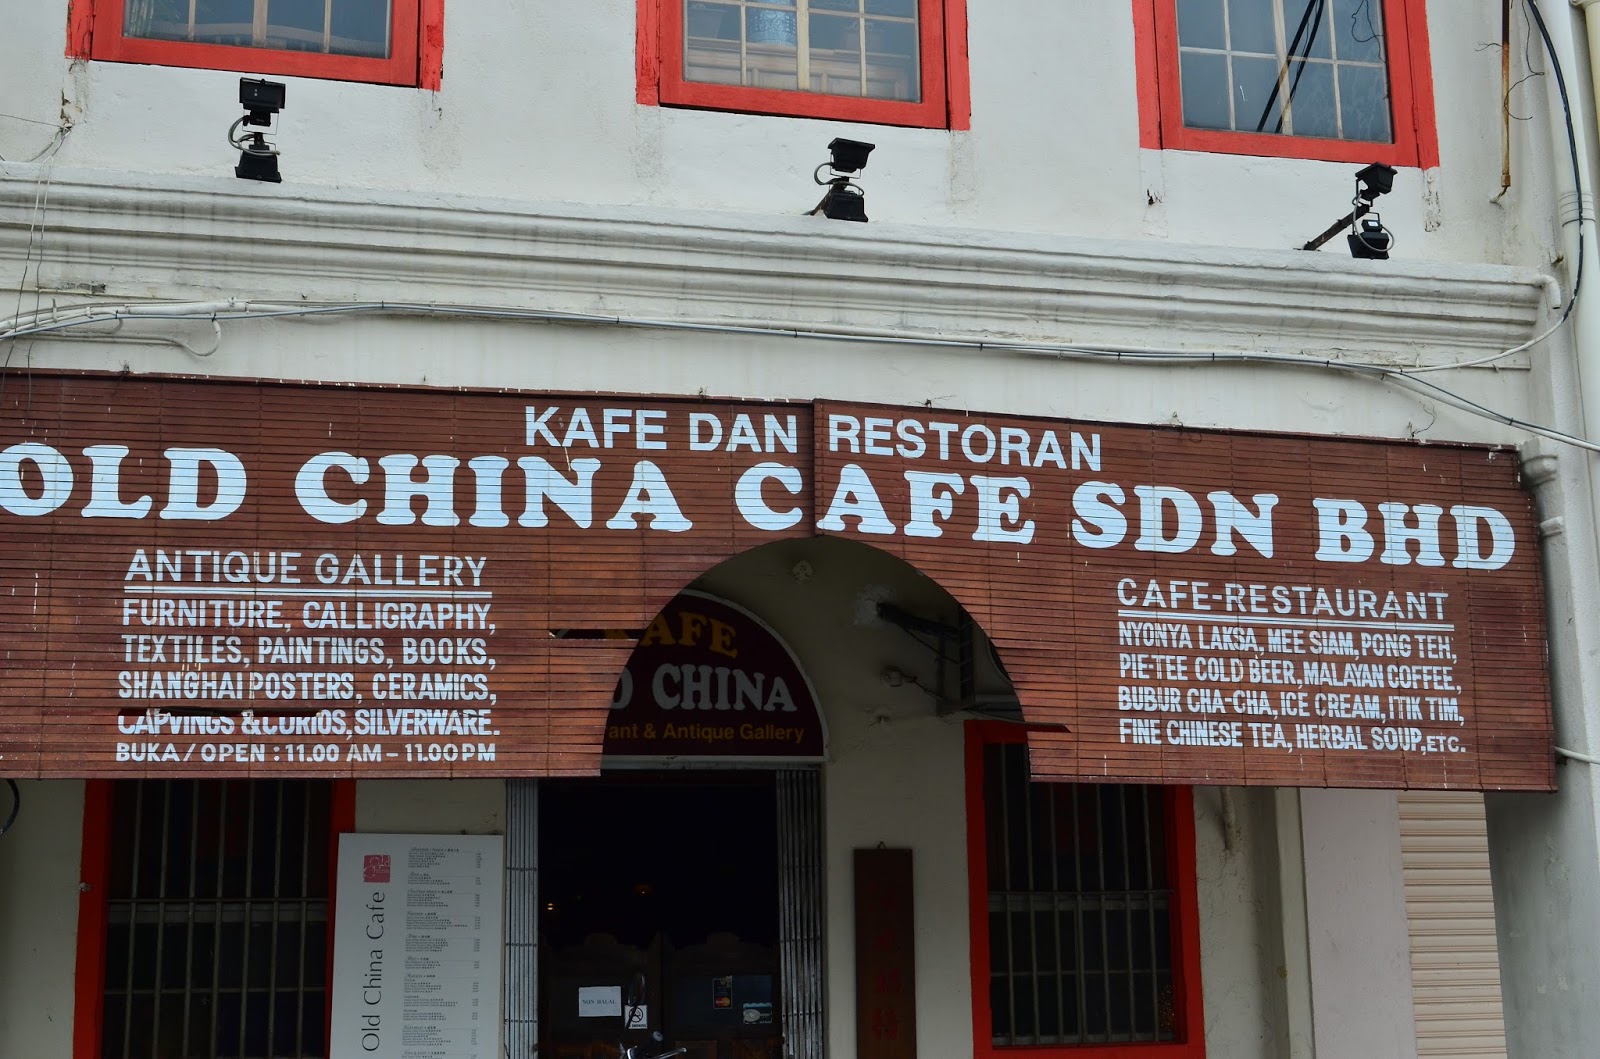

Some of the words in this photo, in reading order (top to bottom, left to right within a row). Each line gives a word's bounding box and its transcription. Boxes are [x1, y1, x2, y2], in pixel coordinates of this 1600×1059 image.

[526, 406, 667, 449] KAFE
[690, 413, 797, 453] DAN
[829, 414, 1102, 472] RESTORAN
[0, 443, 246, 520] OLD
[295, 451, 692, 532] CHINA
[735, 462, 1035, 544] CAFE
[1071, 481, 1279, 559] SDN
[1313, 498, 1515, 569] BHD
[125, 549, 301, 583] ANTIQUE
[315, 554, 486, 586] GALLERY
[123, 599, 291, 632] FURNITURE,
[303, 602, 495, 634] CALLIGRAPHY,
[1118, 578, 1448, 621] CAFE-RESTAURANT
[122, 635, 249, 668] TEXTILES,
[259, 637, 393, 668] PAINTINGS,
[403, 638, 495, 669] BOOKS,
[604, 611, 739, 659] AFE
[1119, 621, 1192, 648] NYONYA
[1199, 626, 1264, 658] LAKSA,
[1268, 629, 1306, 653] MEE
[1309, 631, 1359, 663] SIAM,
[1361, 633, 1411, 657] PONG
[1414, 635, 1457, 667] TEH,
[119, 670, 242, 699] SHANGHAI
[249, 672, 362, 703] POSTERS,
[373, 673, 496, 705] CERAMICS,
[652, 663, 798, 711] CHINA
[1120, 653, 1188, 680] PIE-TEE
[1195, 657, 1243, 682] COLD
[1249, 659, 1302, 689] BEER,
[1303, 661, 1384, 687] MALAYAN
[1387, 665, 1461, 697] COFFEE,
[1118, 686, 1181, 712] BUBUR
[1187, 689, 1278, 722] CHA-CHA,
[1281, 692, 1310, 716] ICE
[1315, 693, 1385, 726] CREAM,
[1389, 696, 1422, 719] ITIK
[1425, 697, 1464, 725] TIM,
[286, 744, 339, 762] 11.00
[346, 744, 381, 762] AM
[406, 744, 458, 761] 11.00
[462, 743, 495, 761] PM
[643, 724, 657, 740] &
[663, 723, 733, 744] Antique
[739, 724, 805, 744] Gallery
[1120, 719, 1161, 744] FINE
[1167, 720, 1243, 746] CHINESE
[1248, 723, 1292, 753] TEA,
[1296, 724, 1367, 749] HERBAL
[362, 949, 382, 1005] China
[361, 1015, 381, 1052] Old
